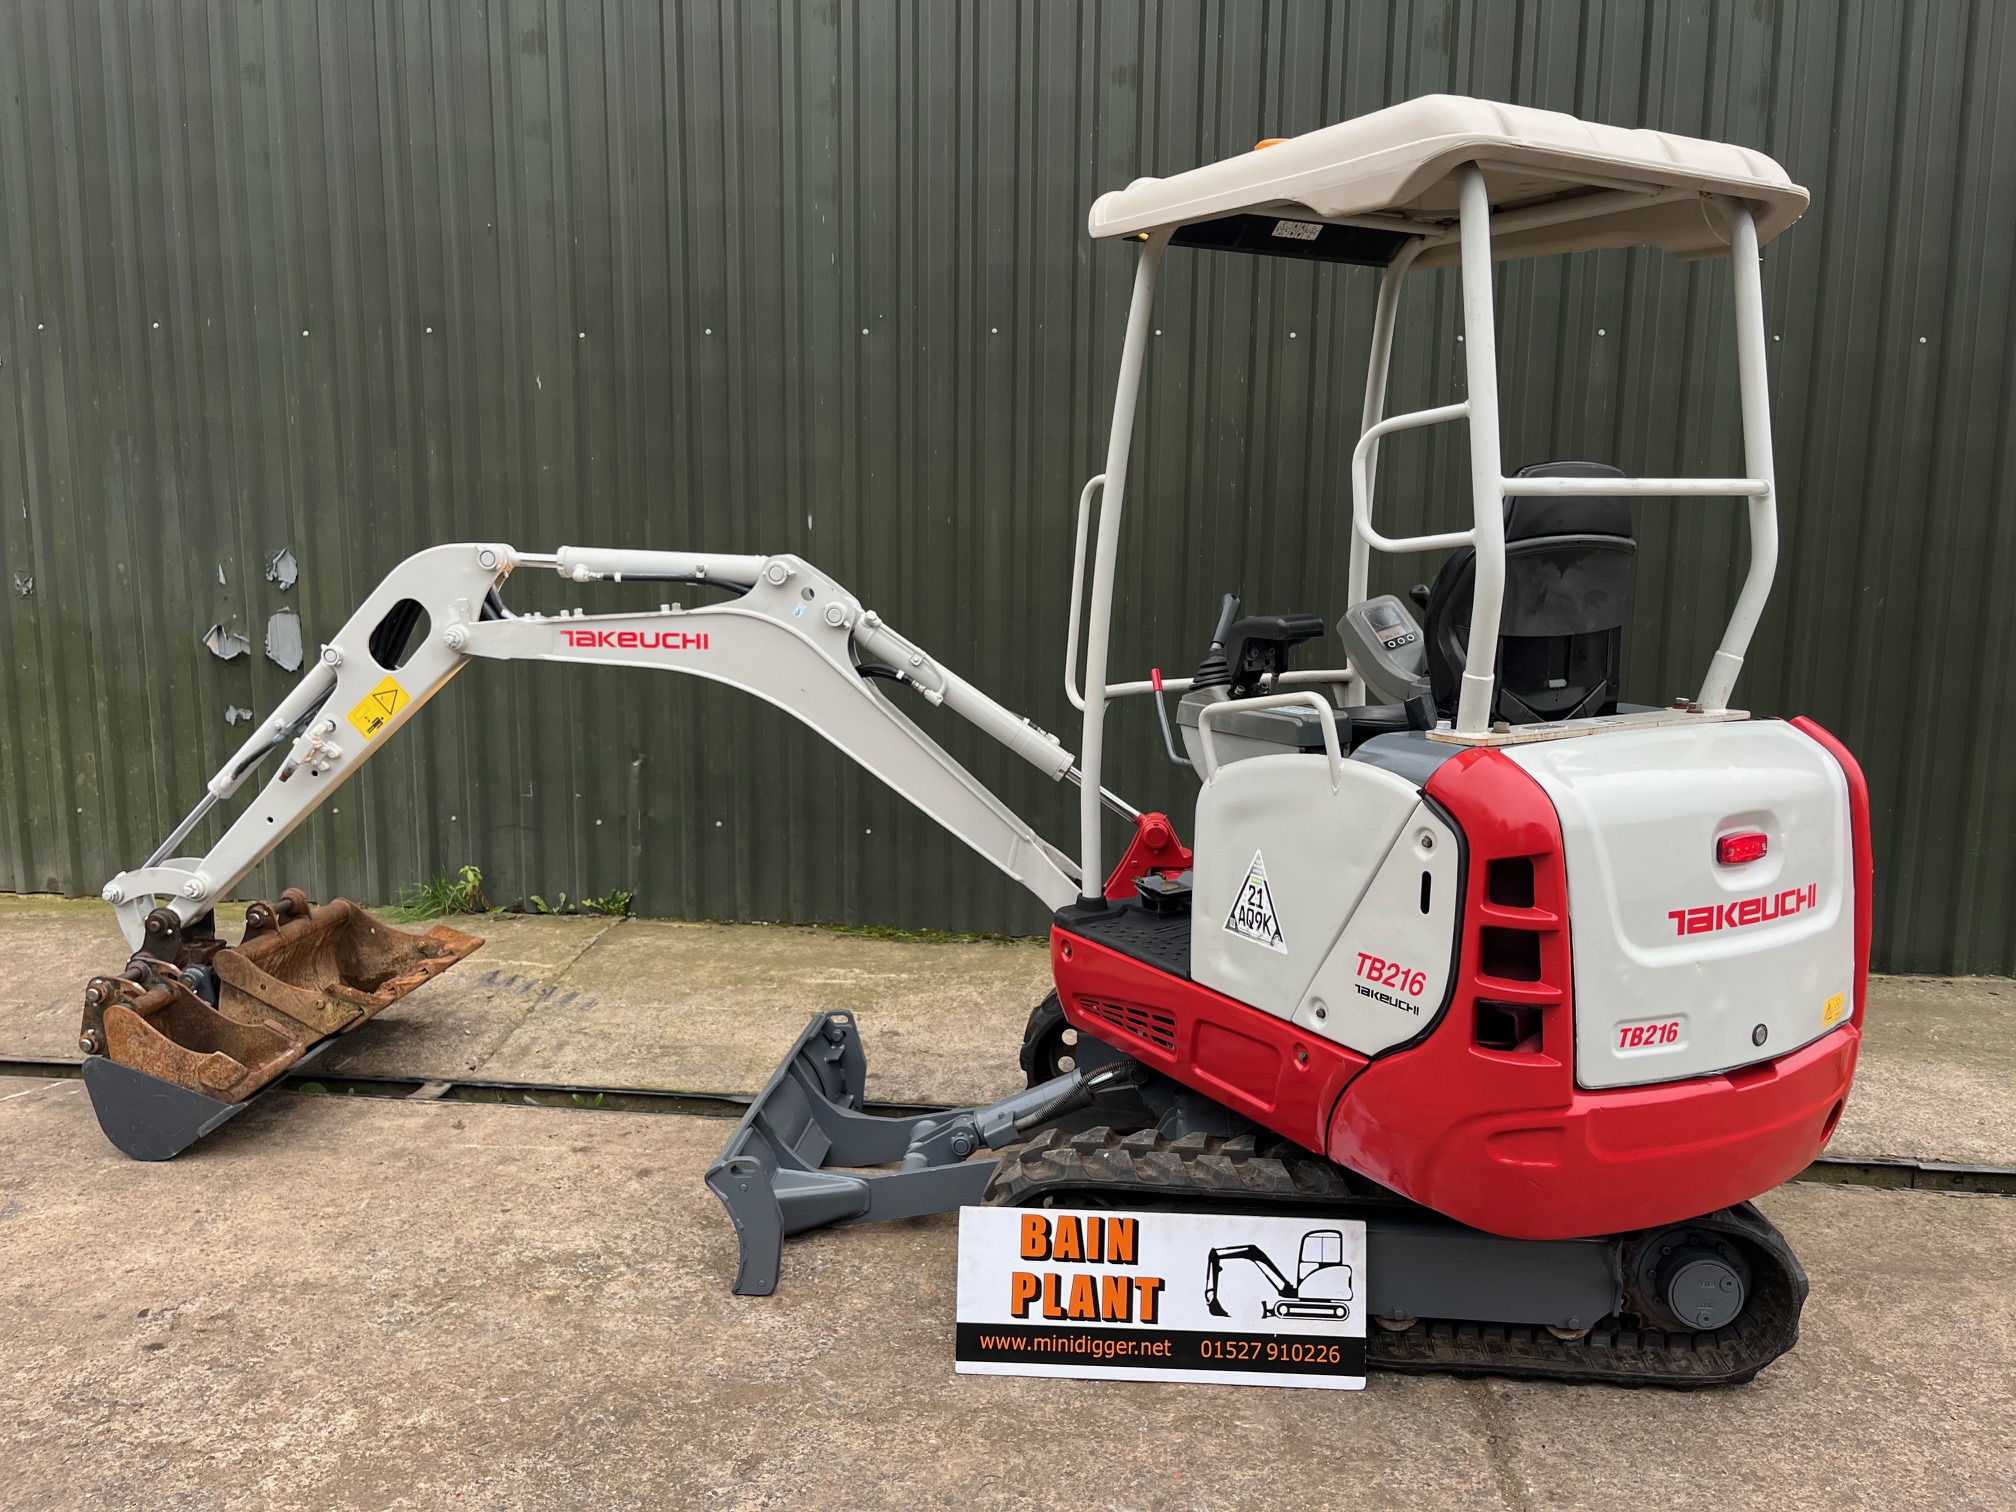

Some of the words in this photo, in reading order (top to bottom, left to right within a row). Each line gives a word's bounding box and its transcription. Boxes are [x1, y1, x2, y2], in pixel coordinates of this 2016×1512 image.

[1247, 884, 1264, 910] 21
[1238, 904, 1272, 937] AQ9K
[1356, 951, 1427, 997] TB216
[1619, 1021, 1680, 1048] TB216
[1020, 1213, 1139, 1266] BAIN
[1011, 1271, 1165, 1324] PLANT
[979, 1334, 1172, 1358] www.minidigger.net
[1200, 1339, 1262, 1361] 01527
[1266, 1343, 1340, 1364] 910226
